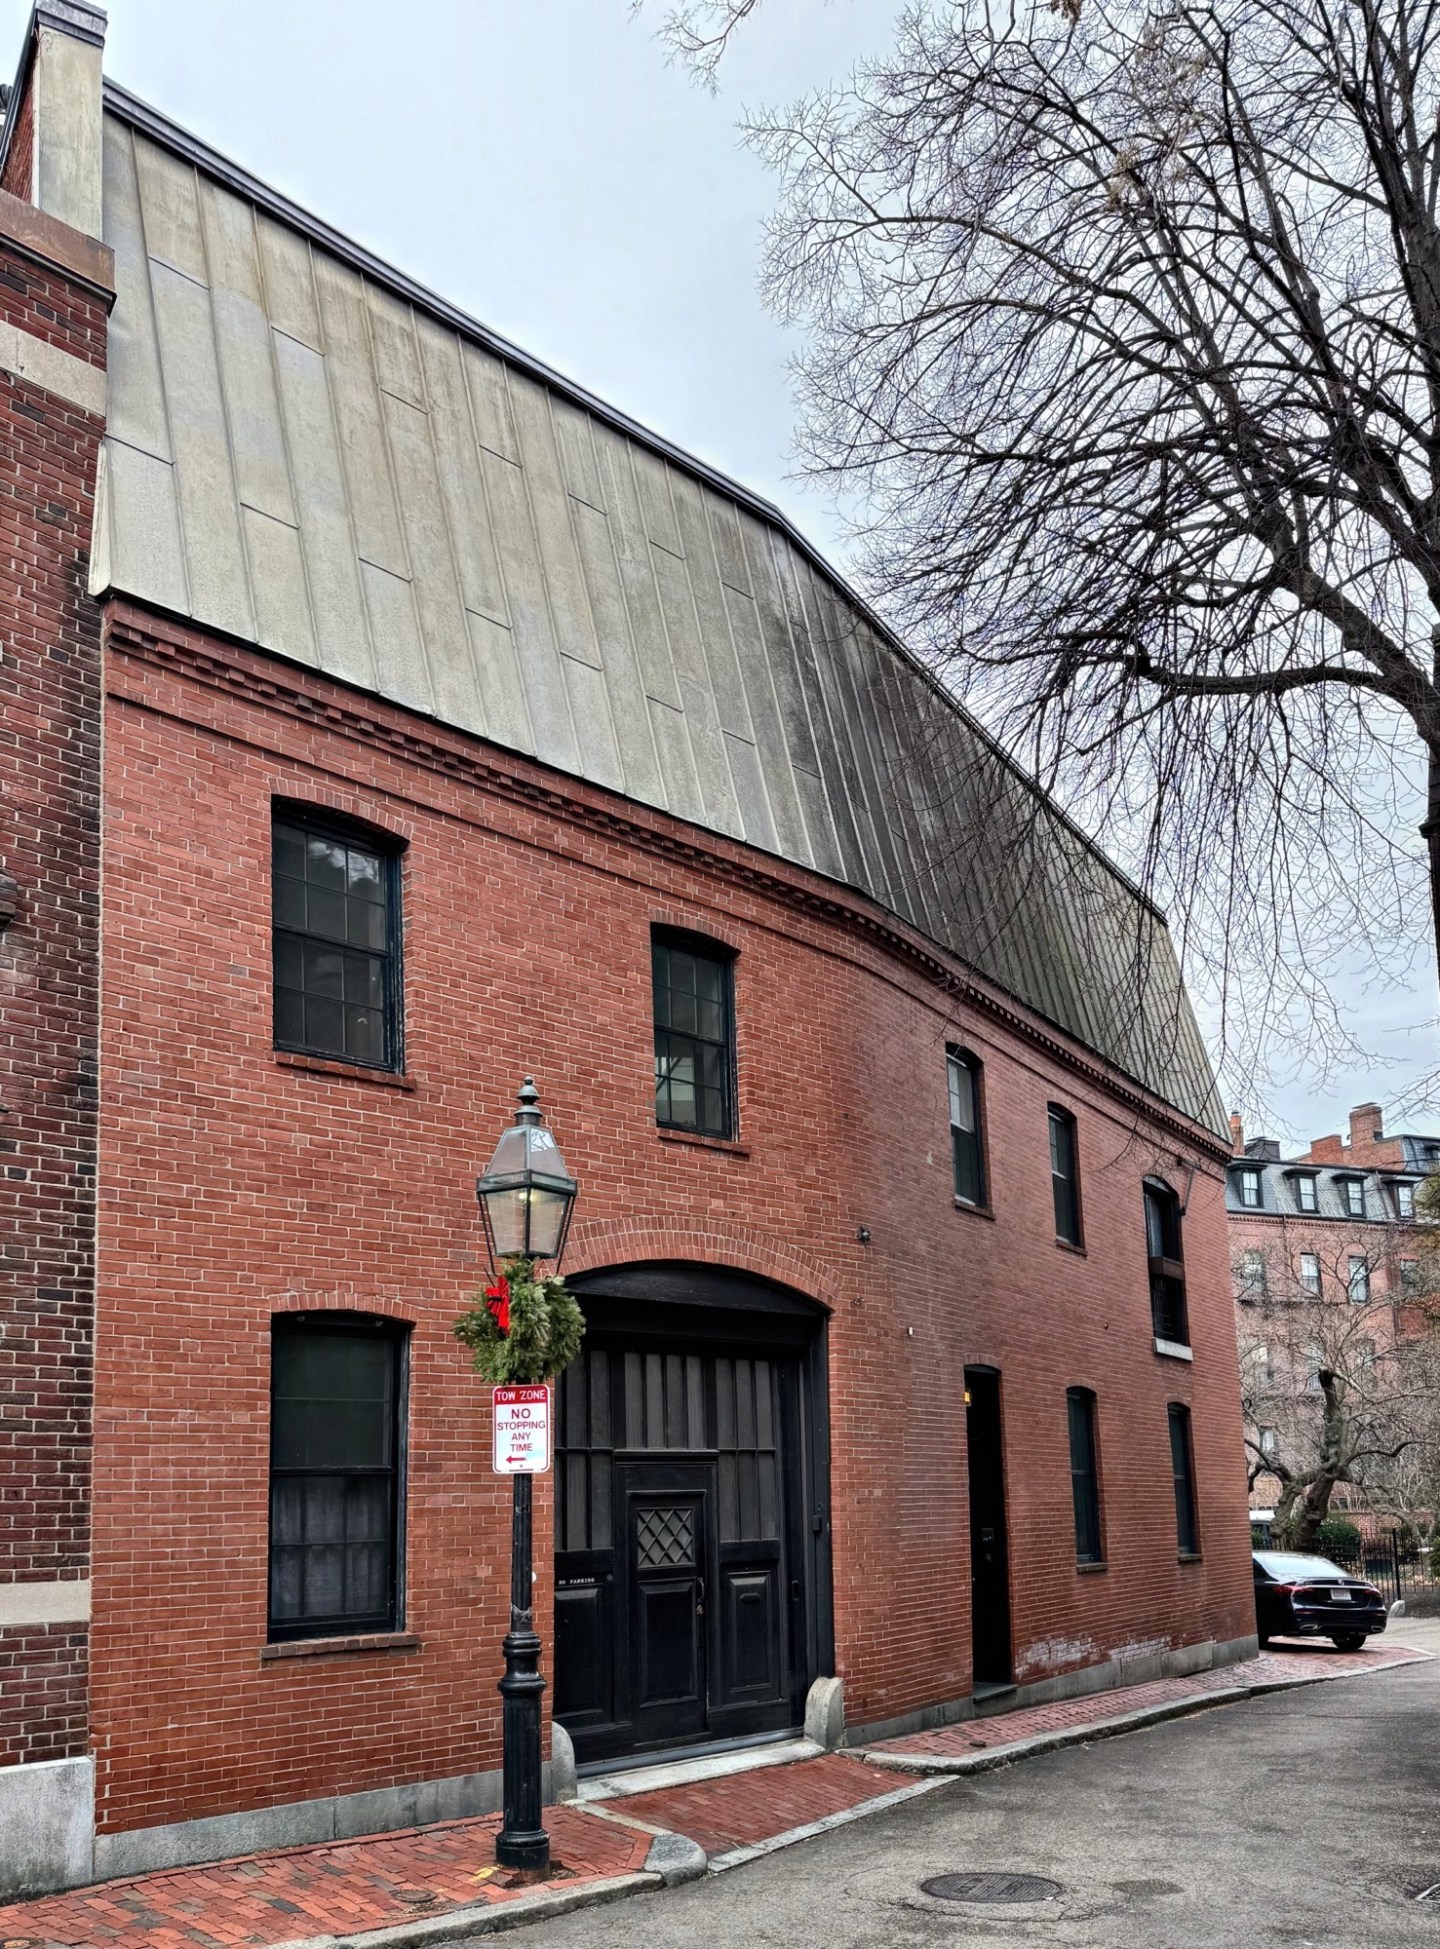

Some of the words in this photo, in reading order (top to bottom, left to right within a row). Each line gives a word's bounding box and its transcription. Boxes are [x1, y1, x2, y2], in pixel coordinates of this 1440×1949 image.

[496, 1391, 516, 1401] TOW
[519, 1389, 546, 1400] ZONE
[511, 1408, 531, 1419] NO
[497, 1420, 546, 1431] STOPPING
[511, 1432, 531, 1441] ANY
[509, 1443, 533, 1452] TIME
[569, 1577, 595, 1585] PARKING
